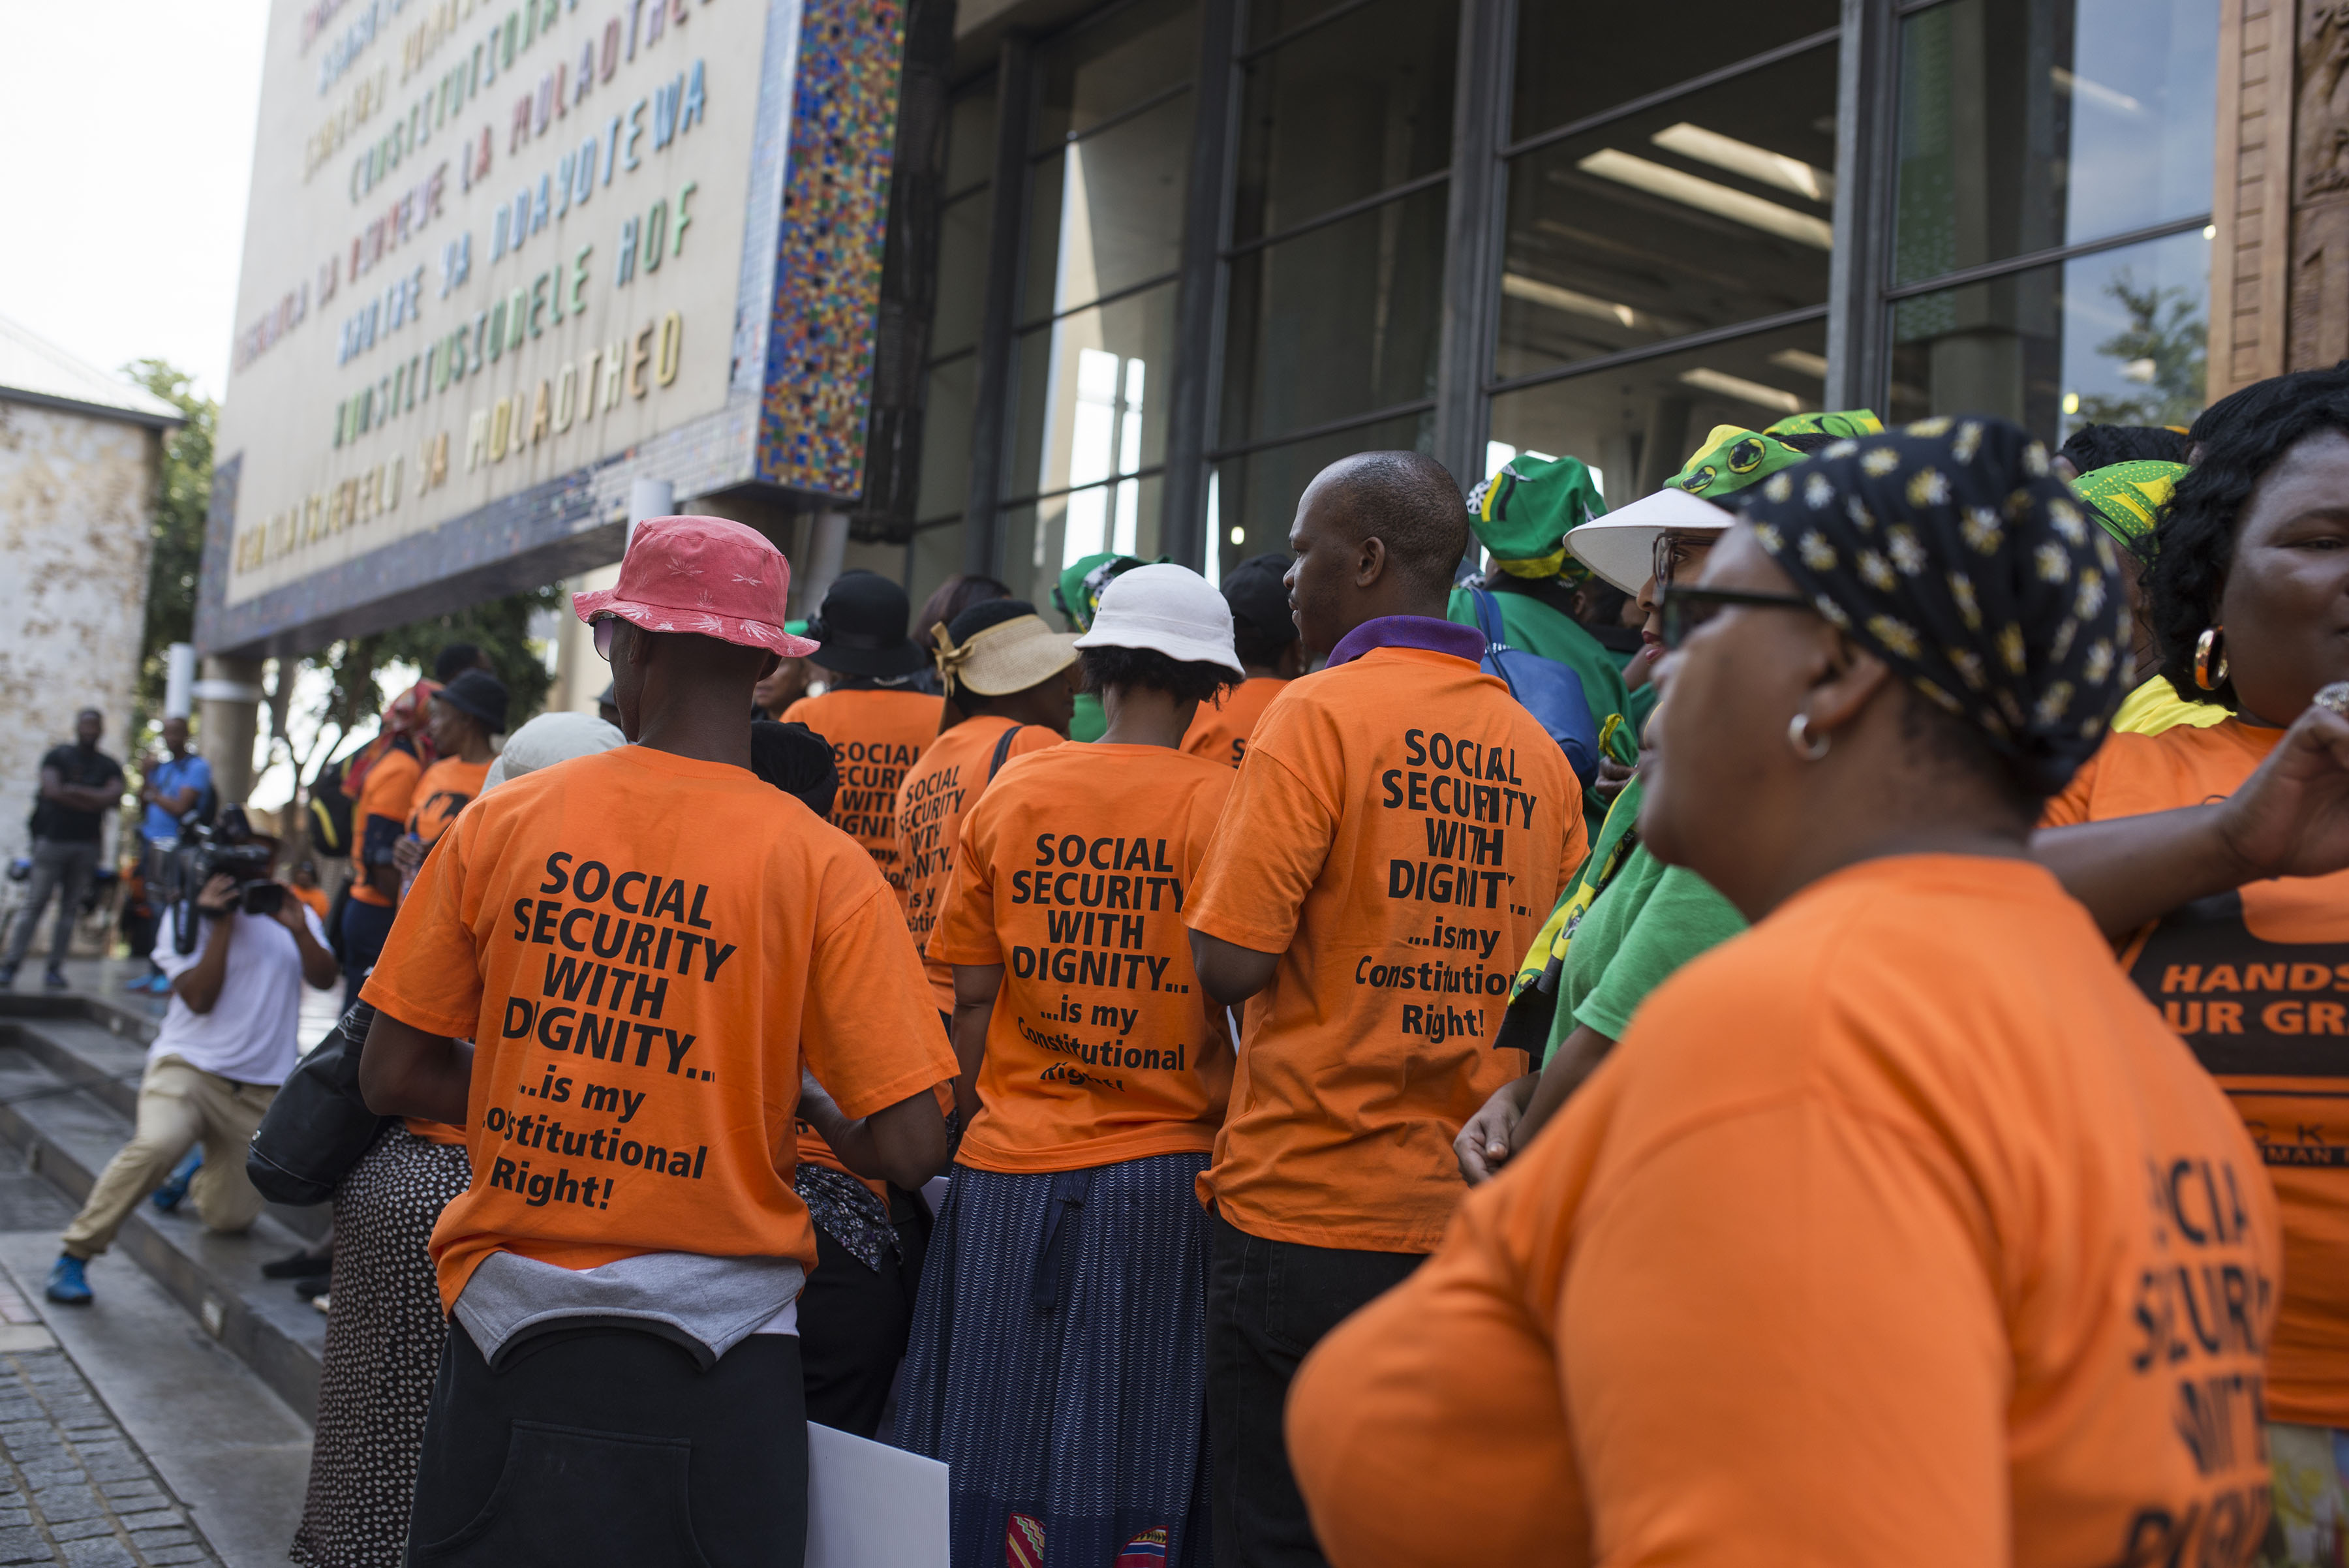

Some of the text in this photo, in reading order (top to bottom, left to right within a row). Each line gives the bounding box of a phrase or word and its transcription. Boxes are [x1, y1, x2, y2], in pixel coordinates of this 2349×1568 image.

[350, 0, 577, 205] CONSTITUTIONA
[616, 180, 698, 288] HOF
[465, 309, 681, 473] MOLAOTHEO
[838, 766, 912, 790] ECURI
[1405, 728, 1522, 786] SOCIAL
[906, 765, 960, 808] SOCIAL
[1381, 769, 1537, 830] SECURITY
[899, 788, 966, 837] SECURITY
[1036, 833, 1173, 872] SOCIAL
[1425, 817, 1504, 867] WITH
[540, 852, 712, 930] SOCIAL
[1011, 870, 1184, 914] SECURITY
[514, 897, 738, 983] SECURITY
[1047, 910, 1144, 950] WITH
[543, 953, 669, 1020] WITH
[1012, 945, 1189, 994] DIGNITY...
[1040, 994, 1139, 1036] ...is my
[1402, 1004, 1484, 1044] Right!
[2262, 1000, 2349, 1036] GR
[1018, 1016, 1185, 1071] Constitutional
[581, 1083, 647, 1124] my
[482, 1107, 708, 1180] ostitutional
[489, 1156, 615, 1210] Right!
